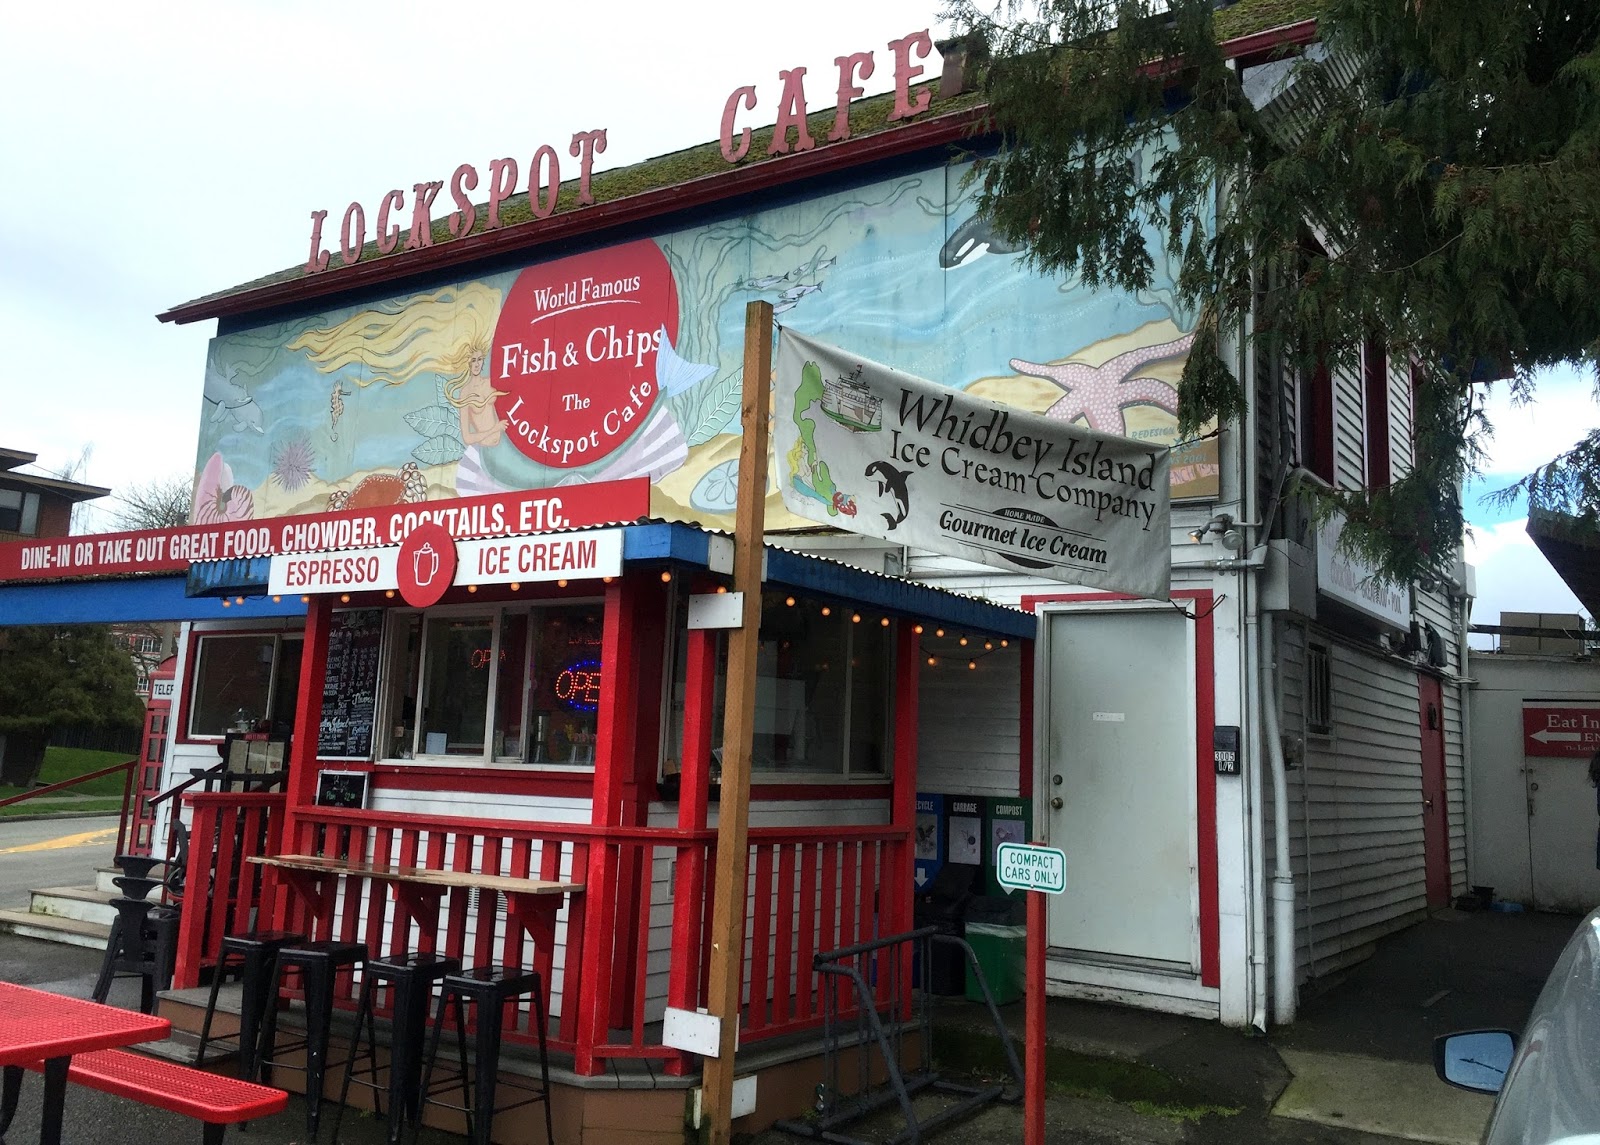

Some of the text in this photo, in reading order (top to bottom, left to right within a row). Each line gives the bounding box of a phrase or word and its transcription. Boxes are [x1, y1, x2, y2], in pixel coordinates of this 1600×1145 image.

[304, 28, 932, 274] LOCKSPOT CAFE
[533, 275, 641, 312] World Famous
[499, 325, 663, 379] Fish & Chips
[562, 393, 591, 412] The
[506, 380, 652, 463] Lockspot Cafe
[898, 388, 1158, 492] Whidbey Island
[889, 429, 1156, 532] Ice Cream Company
[1004, 508, 1046, 524] HOME MADE
[21, 543, 70, 570] DINE-IN
[74, 541, 93, 566] OR
[98, 538, 132, 565] TAKE
[135, 536, 166, 562] OUT
[169, 532, 219, 560] GREAT
[223, 527, 275, 557] FOOD,
[281, 517, 382, 551] CHOWDER,
[520, 497, 570, 531] ETC.
[938, 509, 1108, 564] Gourmet Ice Cream
[285, 539, 597, 587] ESPRESSO ICE CREAM
[555, 670, 602, 702] OPE
[1547, 714, 1600, 729] Eat In
[1215, 751, 1235, 761] 3005
[915, 800, 934, 811] ECYCLE
[953, 802, 977, 813] GARBAGE
[995, 804, 1023, 816] COMPOST
[1005, 866, 1059, 885] CARS ONLY
[1010, 852, 1054, 869] COMPACT
